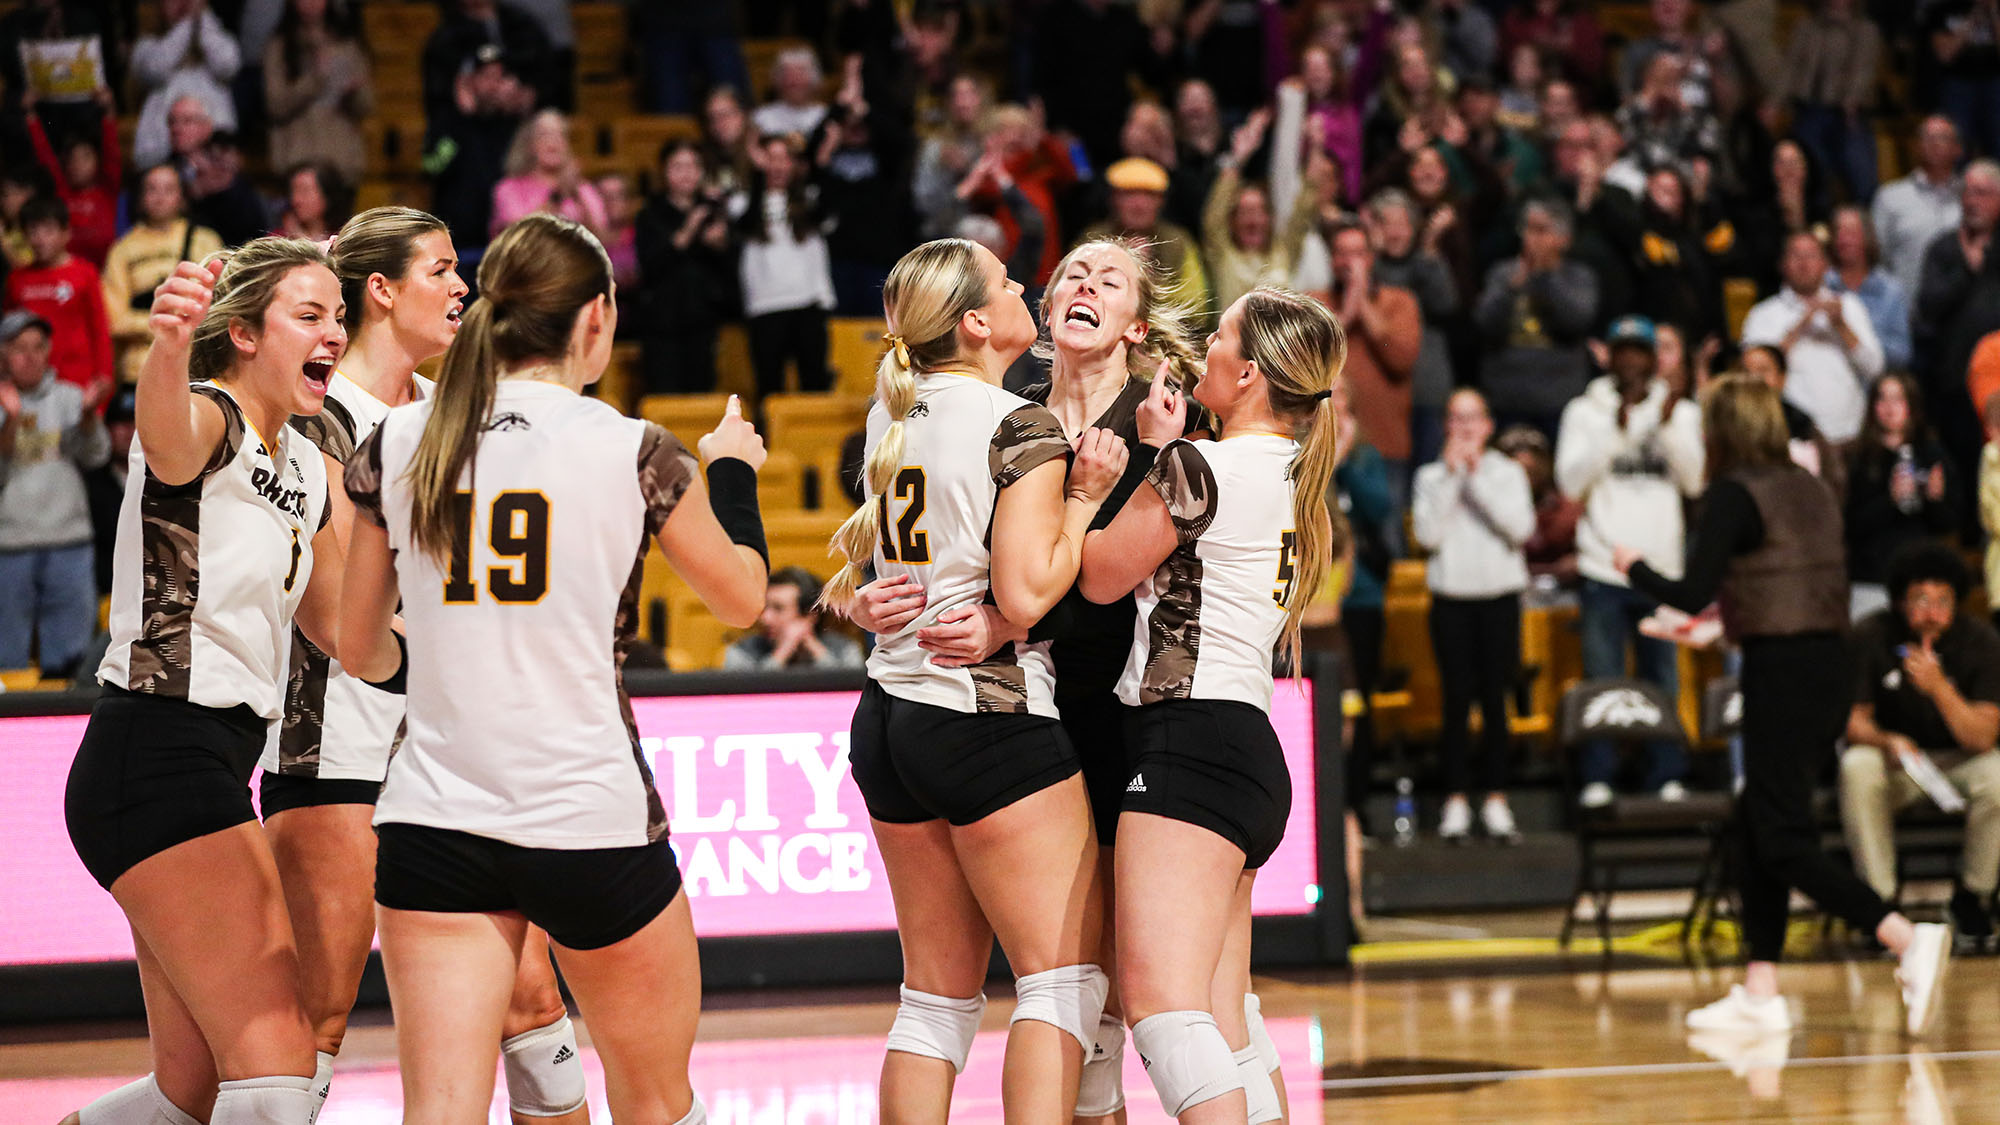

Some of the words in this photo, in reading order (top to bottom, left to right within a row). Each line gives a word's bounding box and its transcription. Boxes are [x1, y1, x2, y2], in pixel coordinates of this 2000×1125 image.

[443, 488, 552, 605] 19
[639, 731, 851, 833] LTY
[668, 832, 872, 898] ANCE
